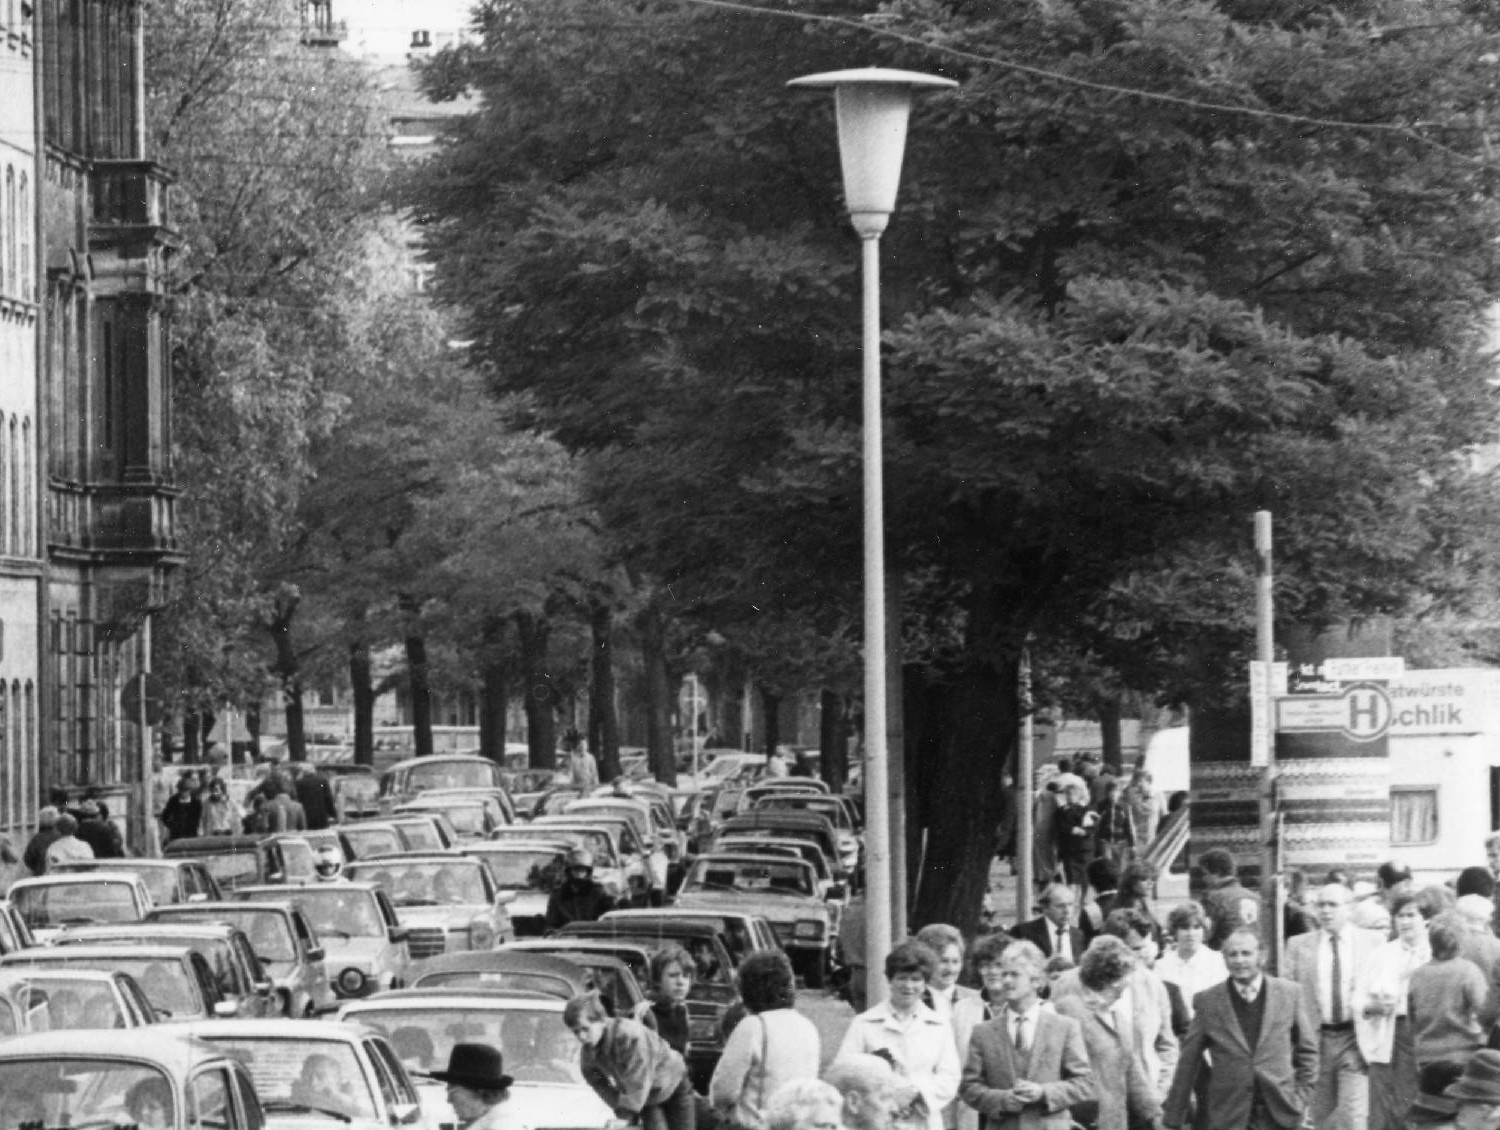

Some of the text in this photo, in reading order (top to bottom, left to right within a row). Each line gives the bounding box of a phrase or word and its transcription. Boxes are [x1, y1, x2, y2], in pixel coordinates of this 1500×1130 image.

[1388, 682, 1465, 698] atwürste
[1349, 694, 1379, 730] H
[1390, 703, 1464, 726] chlik
